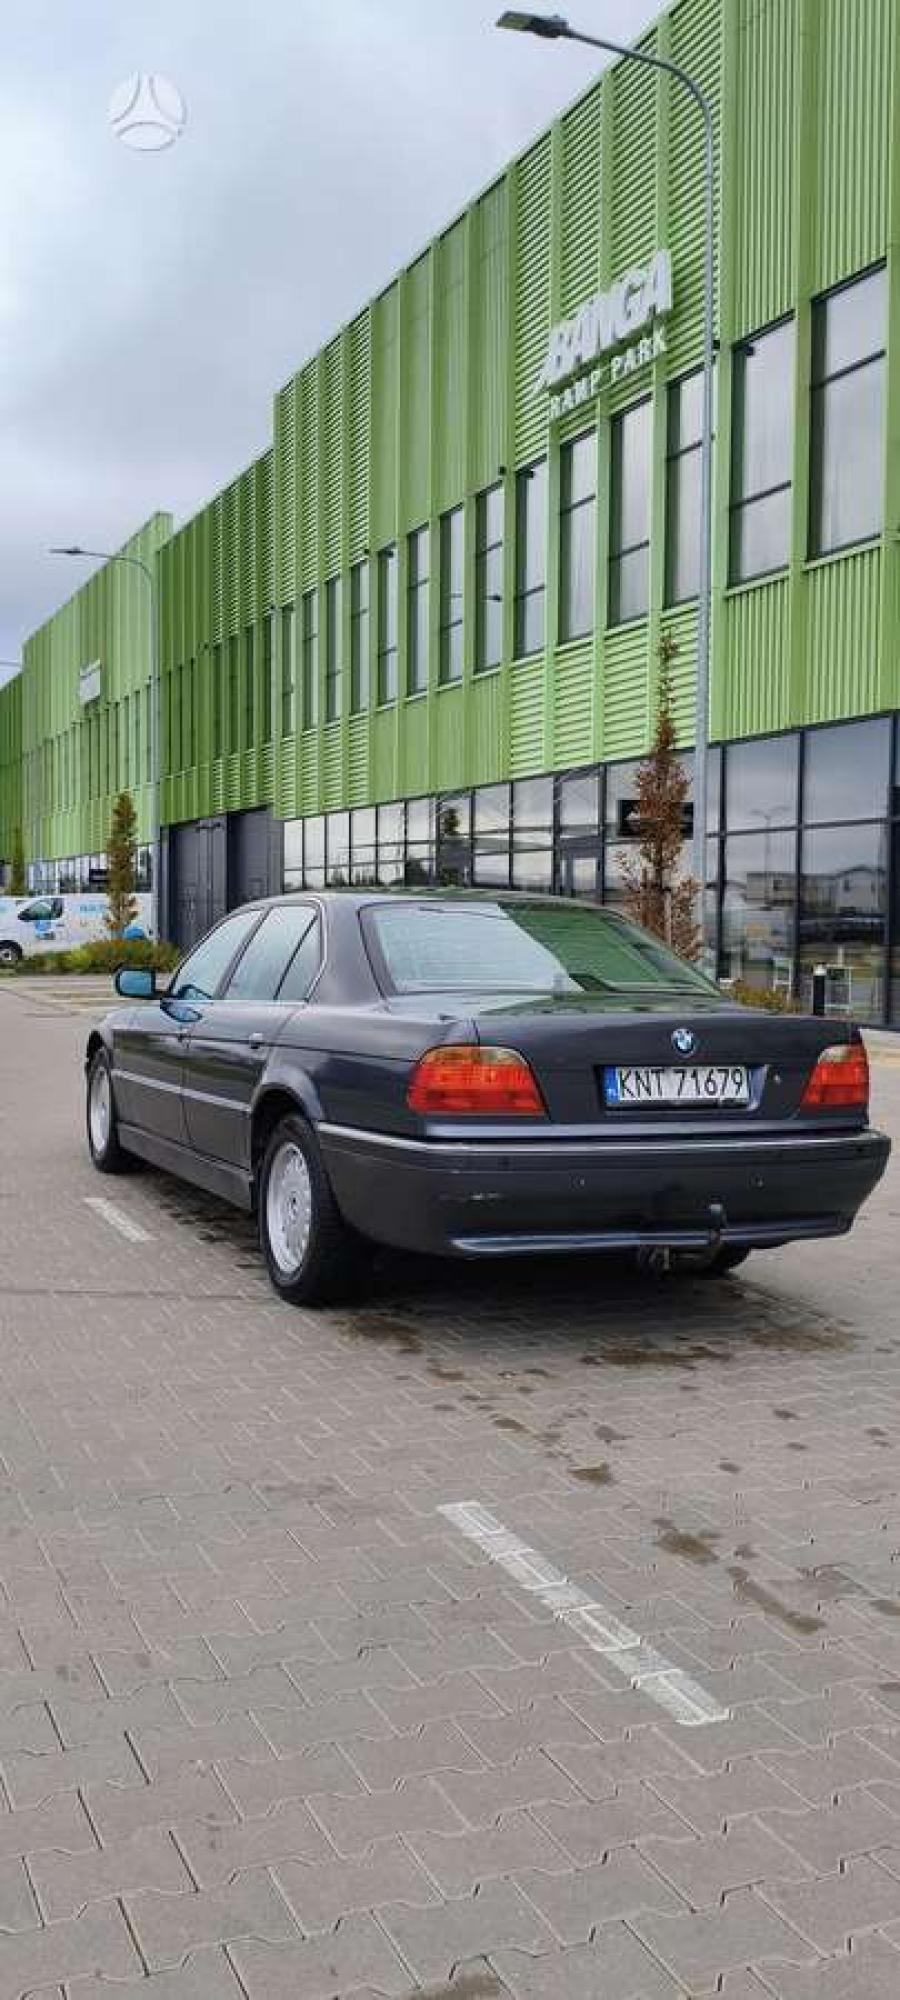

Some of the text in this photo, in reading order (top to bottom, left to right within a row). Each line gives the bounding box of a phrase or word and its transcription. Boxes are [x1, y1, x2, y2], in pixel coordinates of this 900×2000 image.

[550, 327, 668, 419] RAMP PARK
[619, 1067, 665, 1098] KNT
[673, 1067, 744, 1097] 71679
